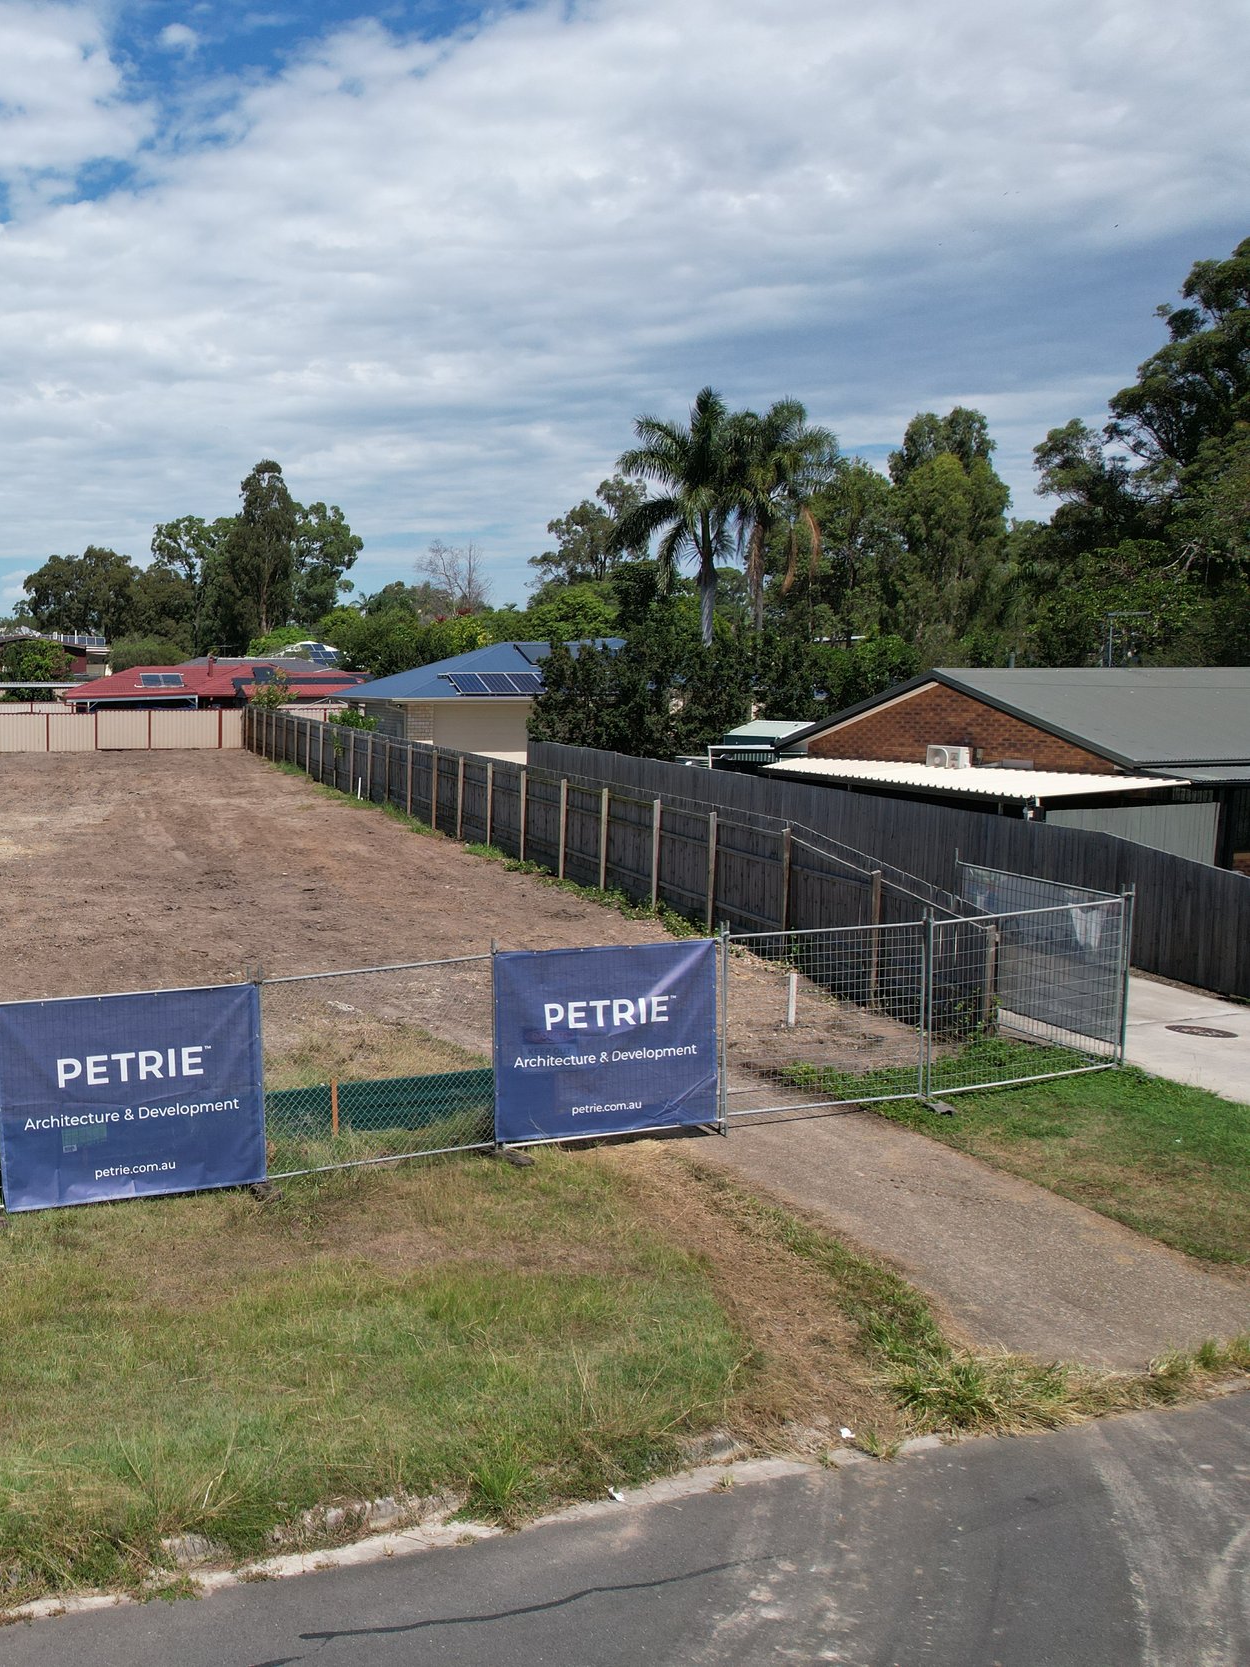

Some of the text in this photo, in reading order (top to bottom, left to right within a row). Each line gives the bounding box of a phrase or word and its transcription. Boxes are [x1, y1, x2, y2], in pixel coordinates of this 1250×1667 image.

[514, 1044, 697, 1068] Architecture & Development
[24, 1098, 239, 1130] Architecture & Development
[572, 1101, 641, 1116] petrie.com.au
[95, 1160, 176, 1180] petrie.com.au
